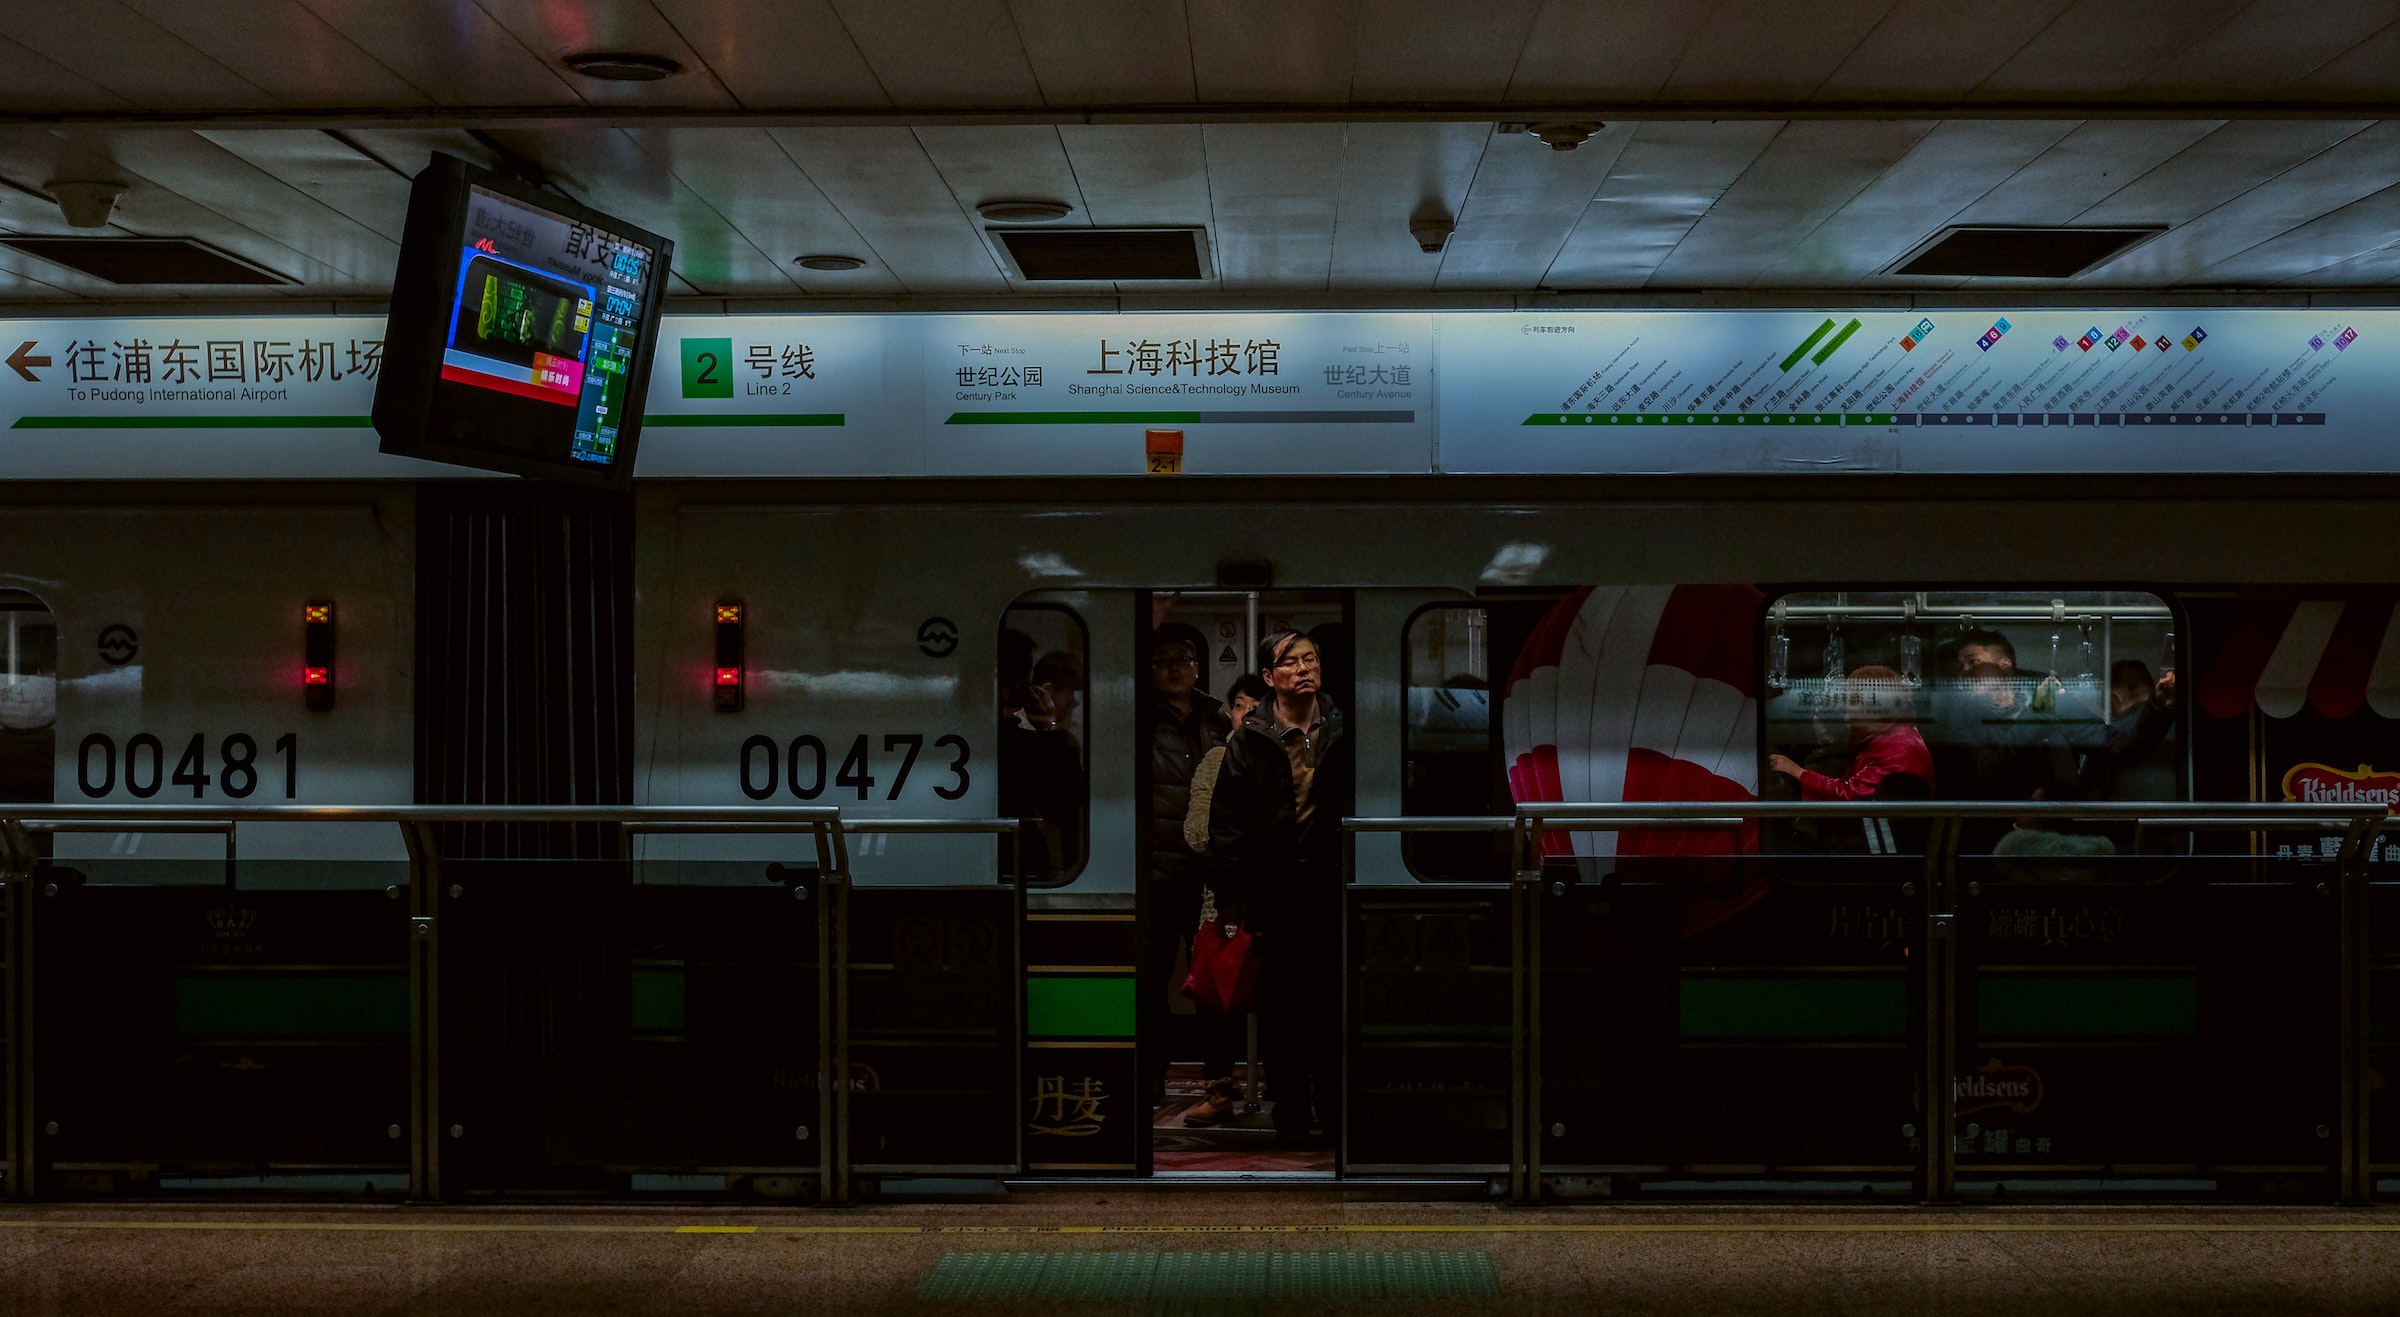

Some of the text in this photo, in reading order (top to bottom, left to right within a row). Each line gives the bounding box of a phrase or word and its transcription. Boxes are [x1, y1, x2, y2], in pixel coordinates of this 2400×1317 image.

[1912, 328, 1923, 340] 16
[1981, 321, 2007, 348] 4 6 9
[2055, 336, 2068, 348] 10
[2082, 330, 2098, 348] 1 8
[2108, 327, 2128, 349] 12 13
[2157, 336, 2170, 349] 11
[2195, 330, 2203, 340] 4
[2310, 336, 2322, 349] 10
[2335, 338, 2347, 349] 10
[2344, 329, 2355, 341] 17
[957, 343, 992, 356] 下一站
[1086, 338, 1281, 377] 上海科技馆
[1374, 342, 1410, 354] 上一站
[65, 338, 385, 384] 往浦东国际机场
[697, 343, 816, 384] 2 号线
[955, 365, 1043, 388] 世纪公园
[1323, 364, 1412, 386] 世纪大道
[67, 387, 288, 404] To Pudong International Airport
[747, 382, 792, 396] Line 2
[956, 391, 1017, 402] Century Park
[1068, 383, 1300, 397] Shanghai Science&Technology Museum
[1337, 389, 1412, 400] Century Avenue
[1865, 383, 1895, 412] 世纪公园
[1890, 376, 1926, 412] 上海科技馆
[1151, 459, 1177, 473] 2-1
[77, 732, 297, 799] 00481
[740, 734, 971, 801] 00473
[1956, 1075, 2030, 1098] eldsens
[1029, 1075, 1111, 1122] 丹麦
